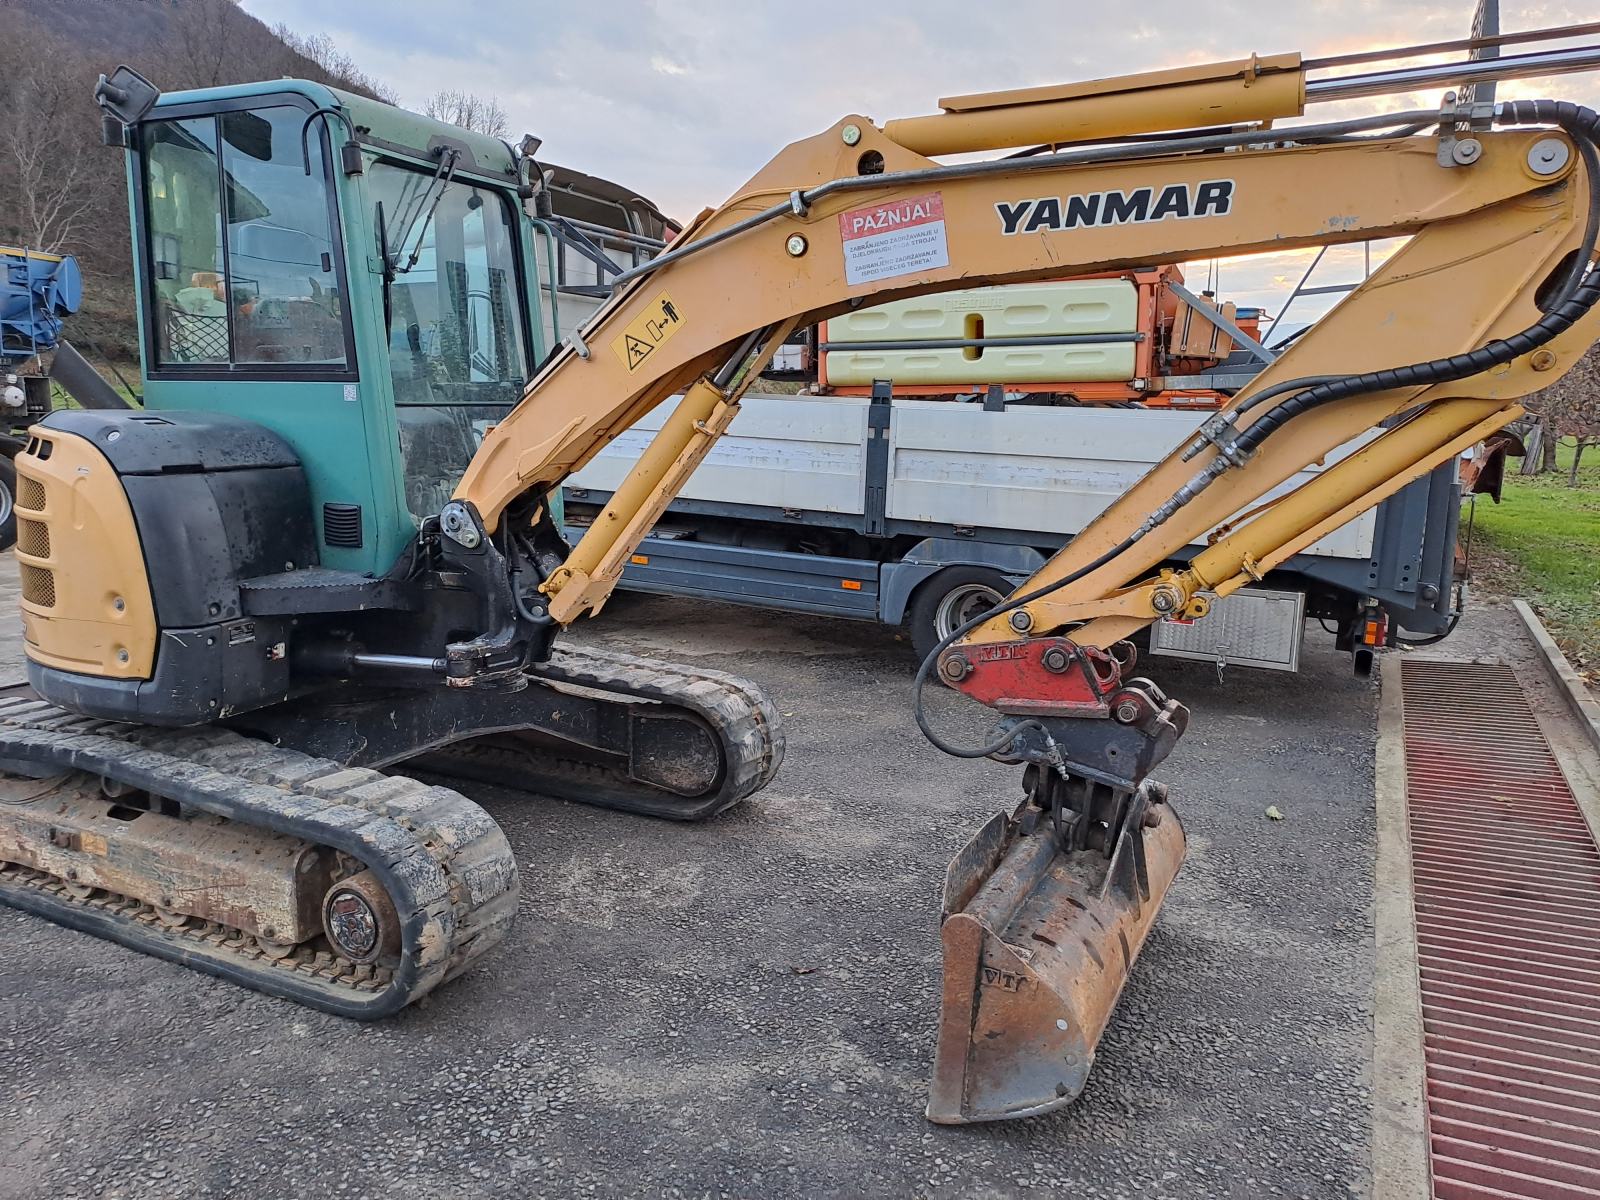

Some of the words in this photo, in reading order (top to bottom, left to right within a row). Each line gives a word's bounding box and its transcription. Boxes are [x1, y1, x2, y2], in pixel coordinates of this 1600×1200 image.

[996, 180, 1233, 234] YANMAR
[853, 201, 931, 233] PAŽNJA!
[911, 236, 937, 246] STROJA!
[895, 249, 938, 263] ZADRŽAVANJE
[907, 256, 932, 267] TERETA!
